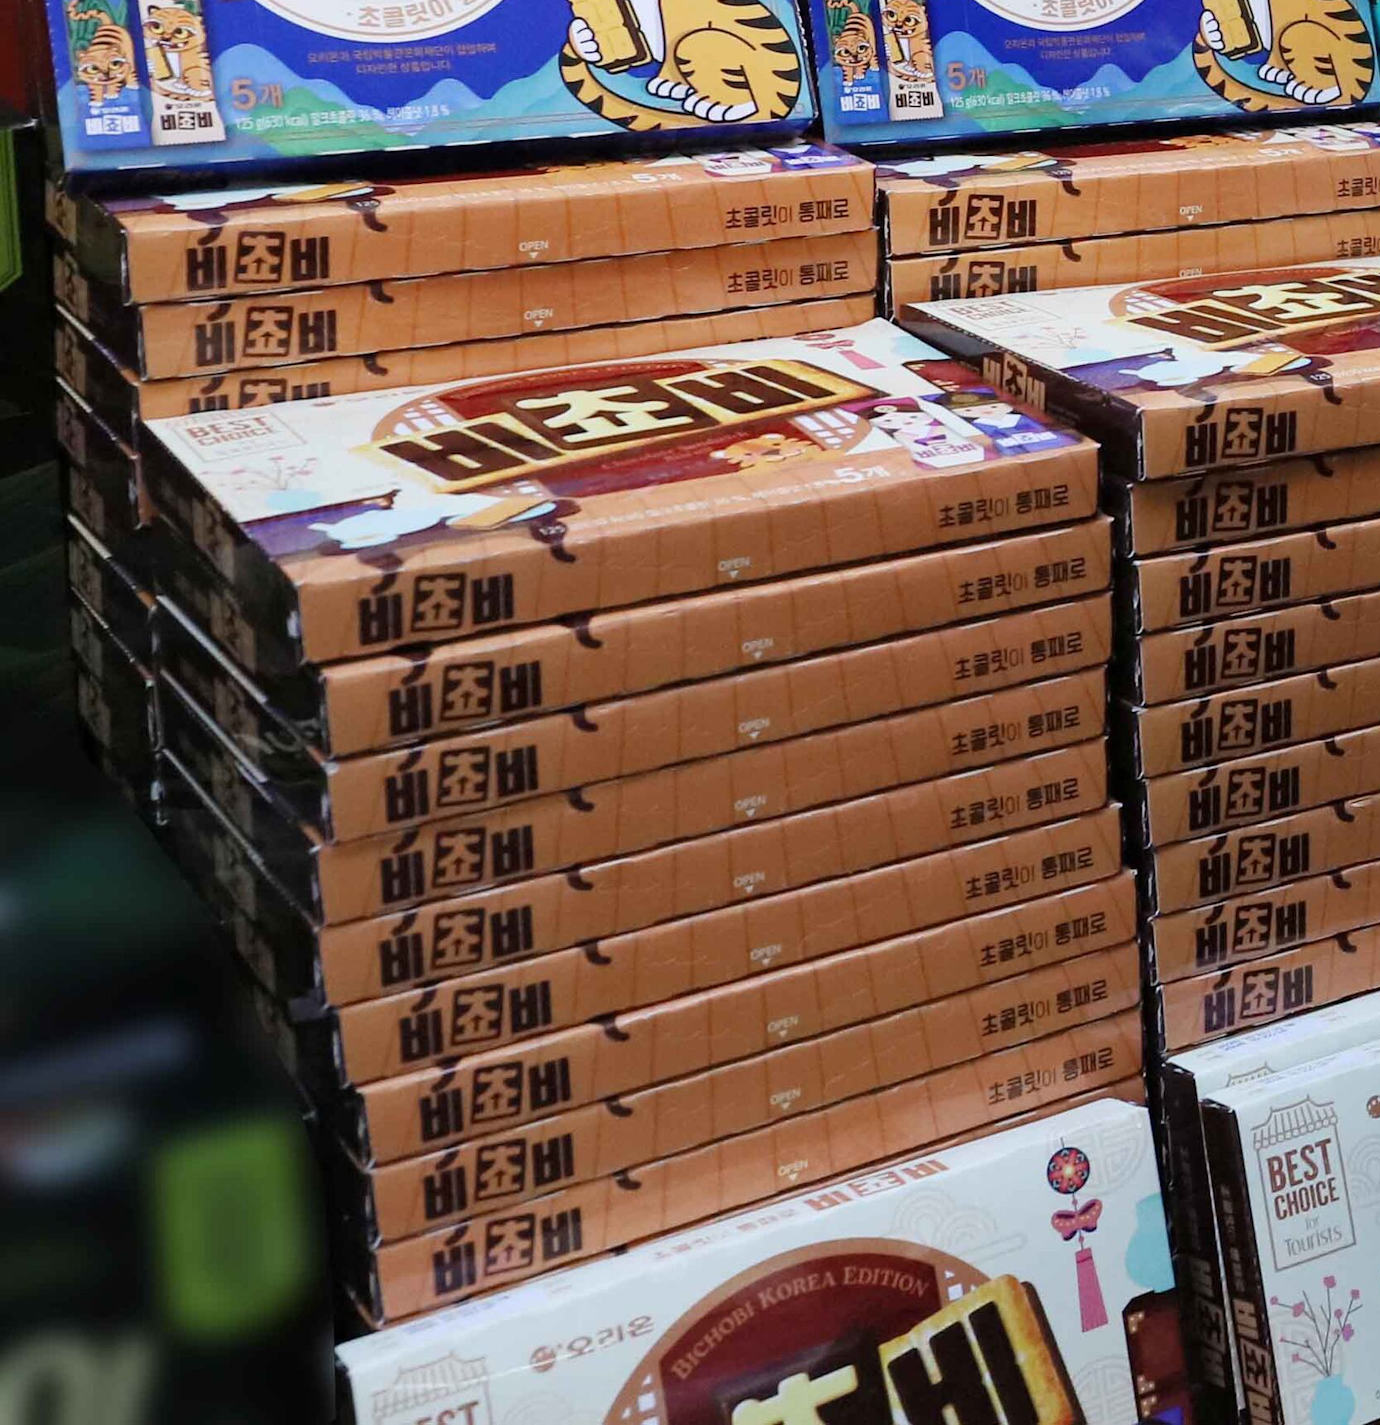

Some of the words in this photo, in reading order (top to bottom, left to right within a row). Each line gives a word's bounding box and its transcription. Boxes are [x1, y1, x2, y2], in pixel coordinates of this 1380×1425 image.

[231, 78, 283, 111] 5개
[948, 62, 987, 93] 5개
[725, 204, 793, 229] 초콜릿이
[798, 197, 849, 223] 통째로
[929, 195, 1037, 246] 비쵸비
[1179, 206, 1203, 216] OPEN
[186, 231, 331, 290] 비쵸비
[519, 240, 550, 252] OPEN
[380, 365, 839, 481] 비쵸비
[1185, 406, 1296, 467] 비쵸비
[359, 572, 514, 645] 비쵸비
[1184, 626, 1295, 690] 비쵸비
[389, 660, 541, 736] 비쵸비
[1200, 833, 1309, 898] 비쵸비
[420, 1058, 570, 1142] 비쵸비
[1268, 1138, 1333, 1188] BEST
[1274, 1180, 1340, 1221] CHOICE
[1284, 1224, 1343, 1257] Tourists
[565, 1311, 655, 1358] 오리온
[670, 1302, 756, 1382] BICHOBI
[758, 1270, 836, 1310] KOREA
[842, 1264, 931, 1298] EDITION
